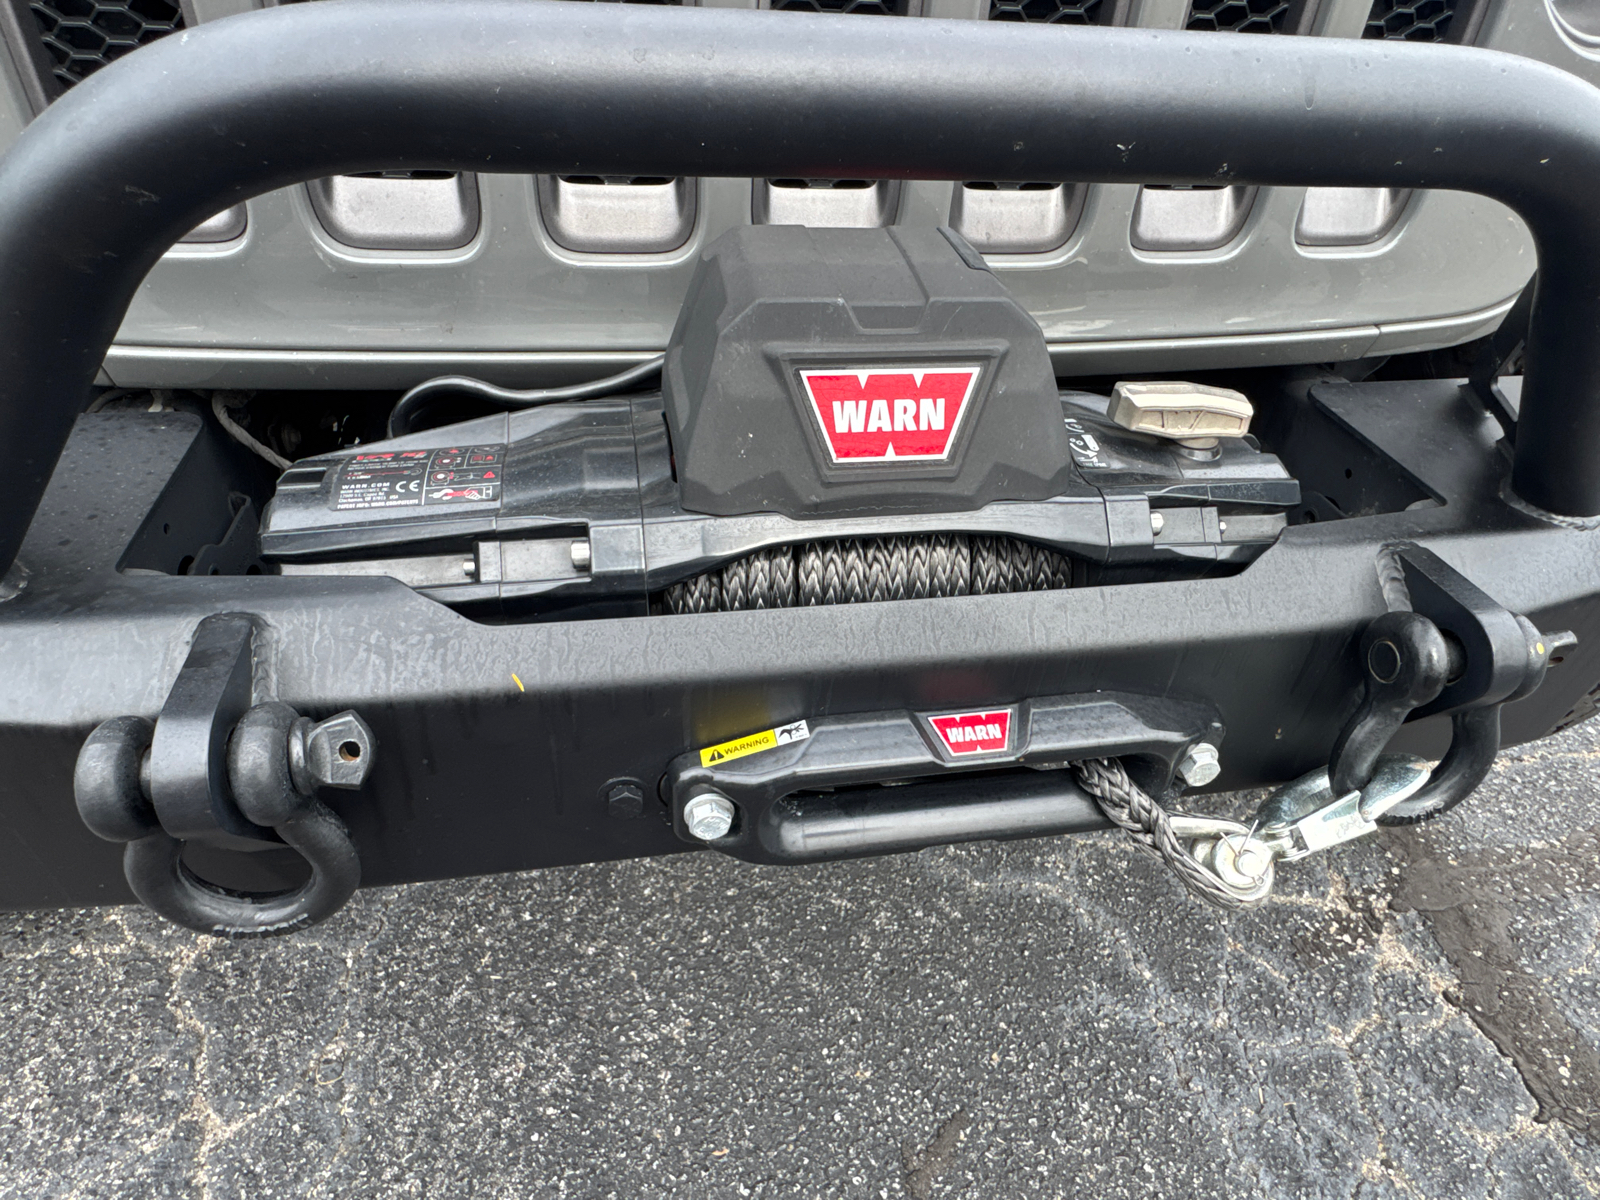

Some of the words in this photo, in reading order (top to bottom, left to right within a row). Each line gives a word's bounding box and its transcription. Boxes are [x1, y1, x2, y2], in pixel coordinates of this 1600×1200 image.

[832, 398, 945, 433] WARN
[341, 482, 390, 490] WARN.COM
[946, 723, 1003, 743] WARN
[724, 736, 770, 755] WARNING
